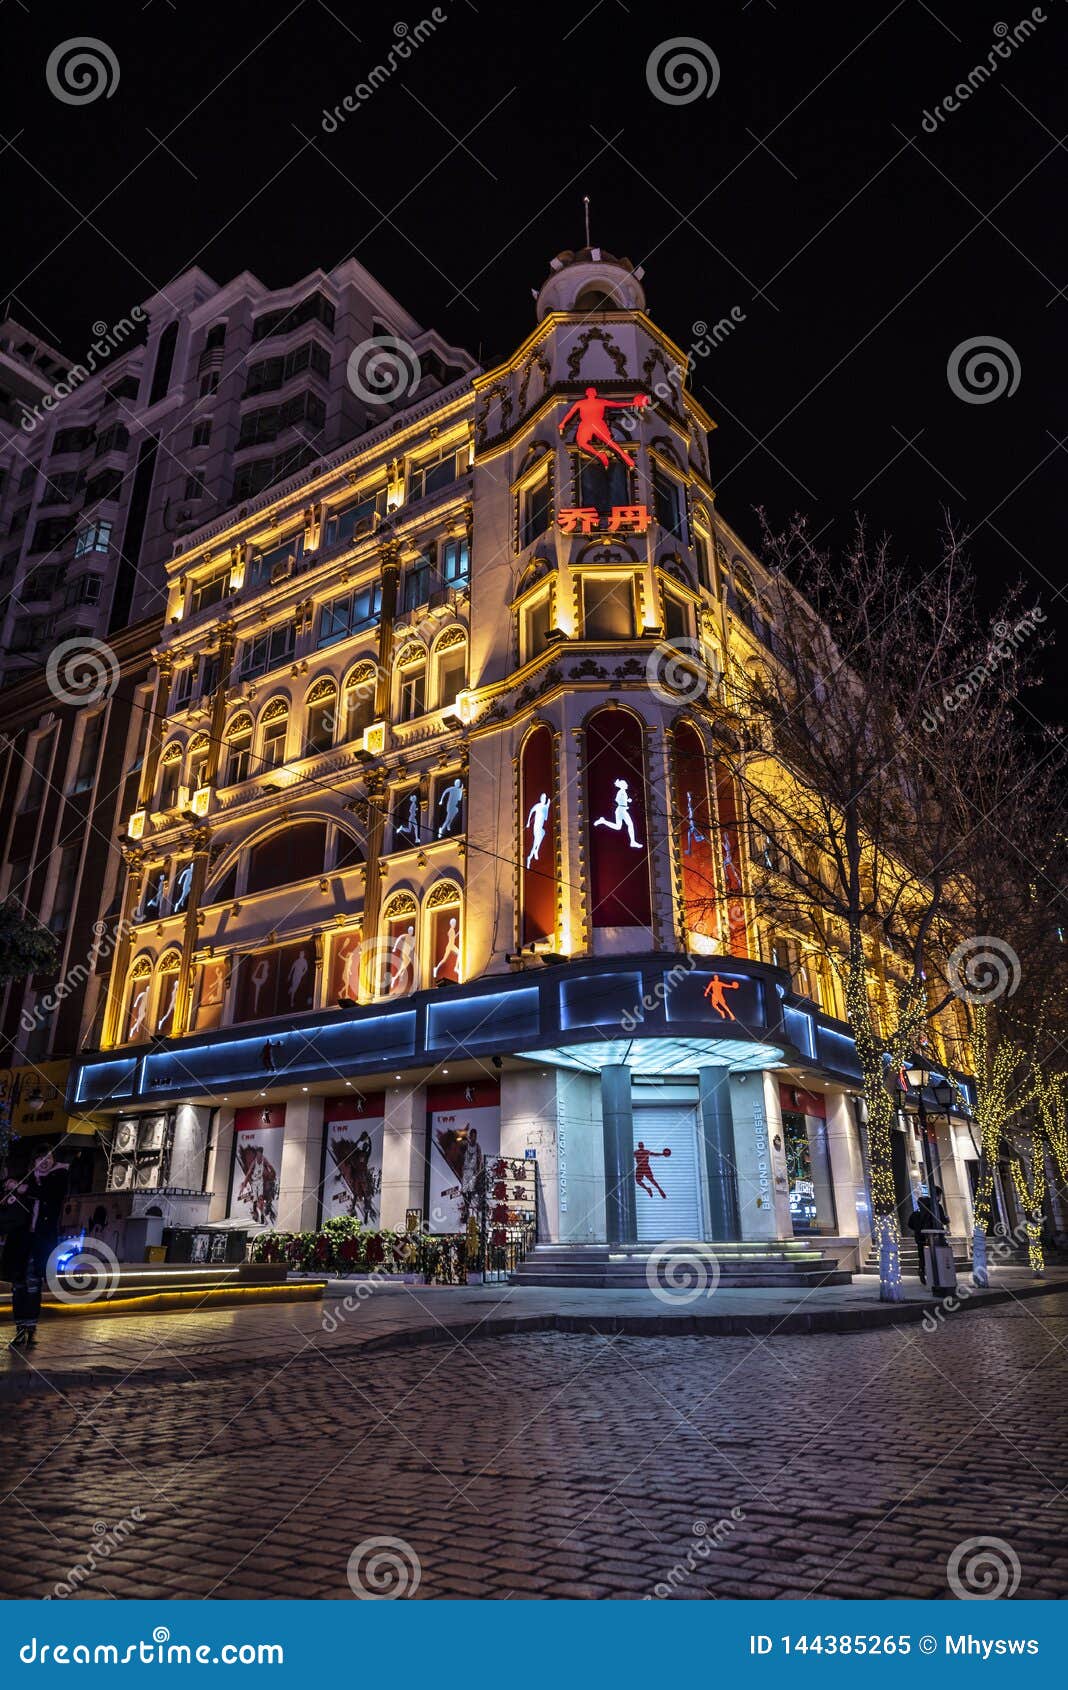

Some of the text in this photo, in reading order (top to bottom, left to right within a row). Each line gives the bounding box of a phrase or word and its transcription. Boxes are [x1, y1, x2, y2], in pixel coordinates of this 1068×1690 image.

[558, 506, 651, 532] 乔丹
[753, 1101, 771, 1211] BEYOND YOURSELF
